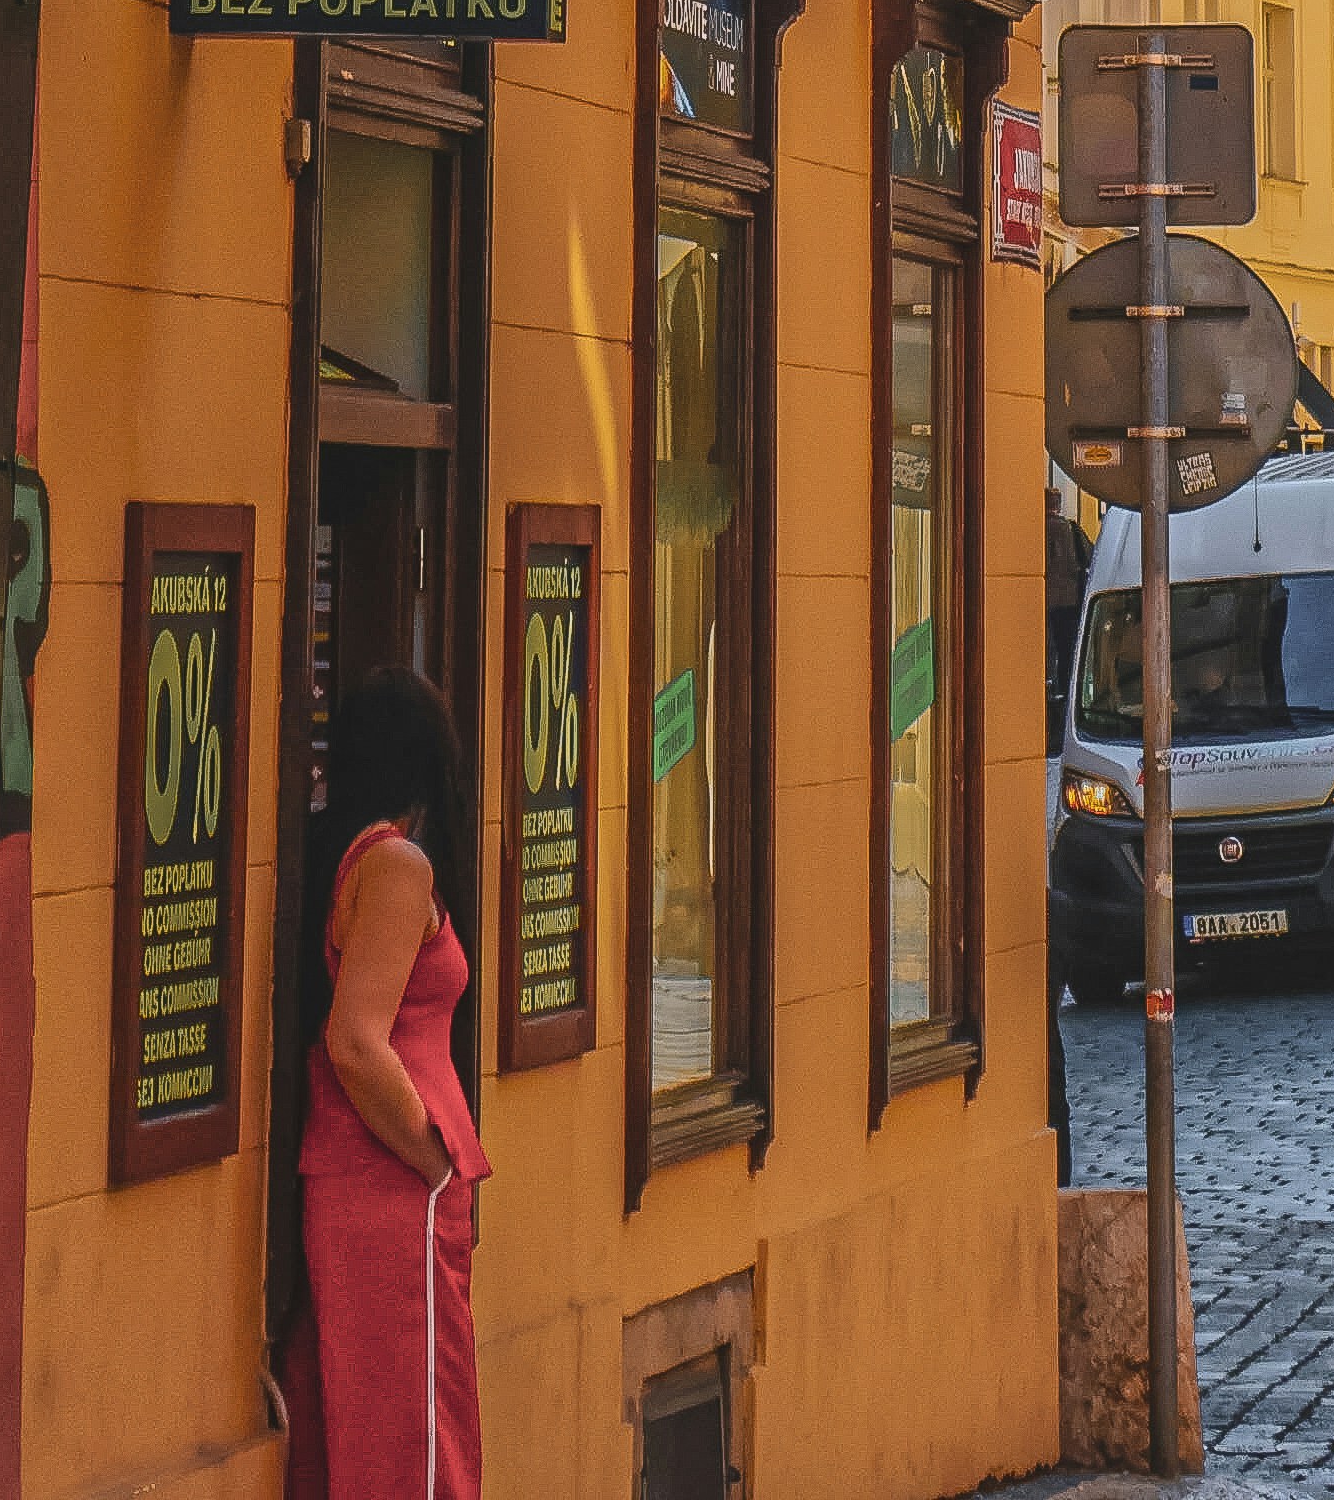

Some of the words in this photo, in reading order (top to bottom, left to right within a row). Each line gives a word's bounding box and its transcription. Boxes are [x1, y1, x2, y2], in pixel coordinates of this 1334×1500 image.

[708, 6, 744, 53] MUSEUM
[151, 564, 210, 615] AKUBSKÁ
[214, 573, 227, 612] 12
[527, 558, 568, 598] AKUBSKÁ
[570, 566, 581, 598] 12
[524, 610, 578, 794] 0%
[145, 626, 222, 846] 0%
[144, 866, 165, 897] BEZ
[166, 859, 214, 894] POPLATKU
[156, 897, 217, 935] COMMISSION
[139, 988, 159, 1020] ANS
